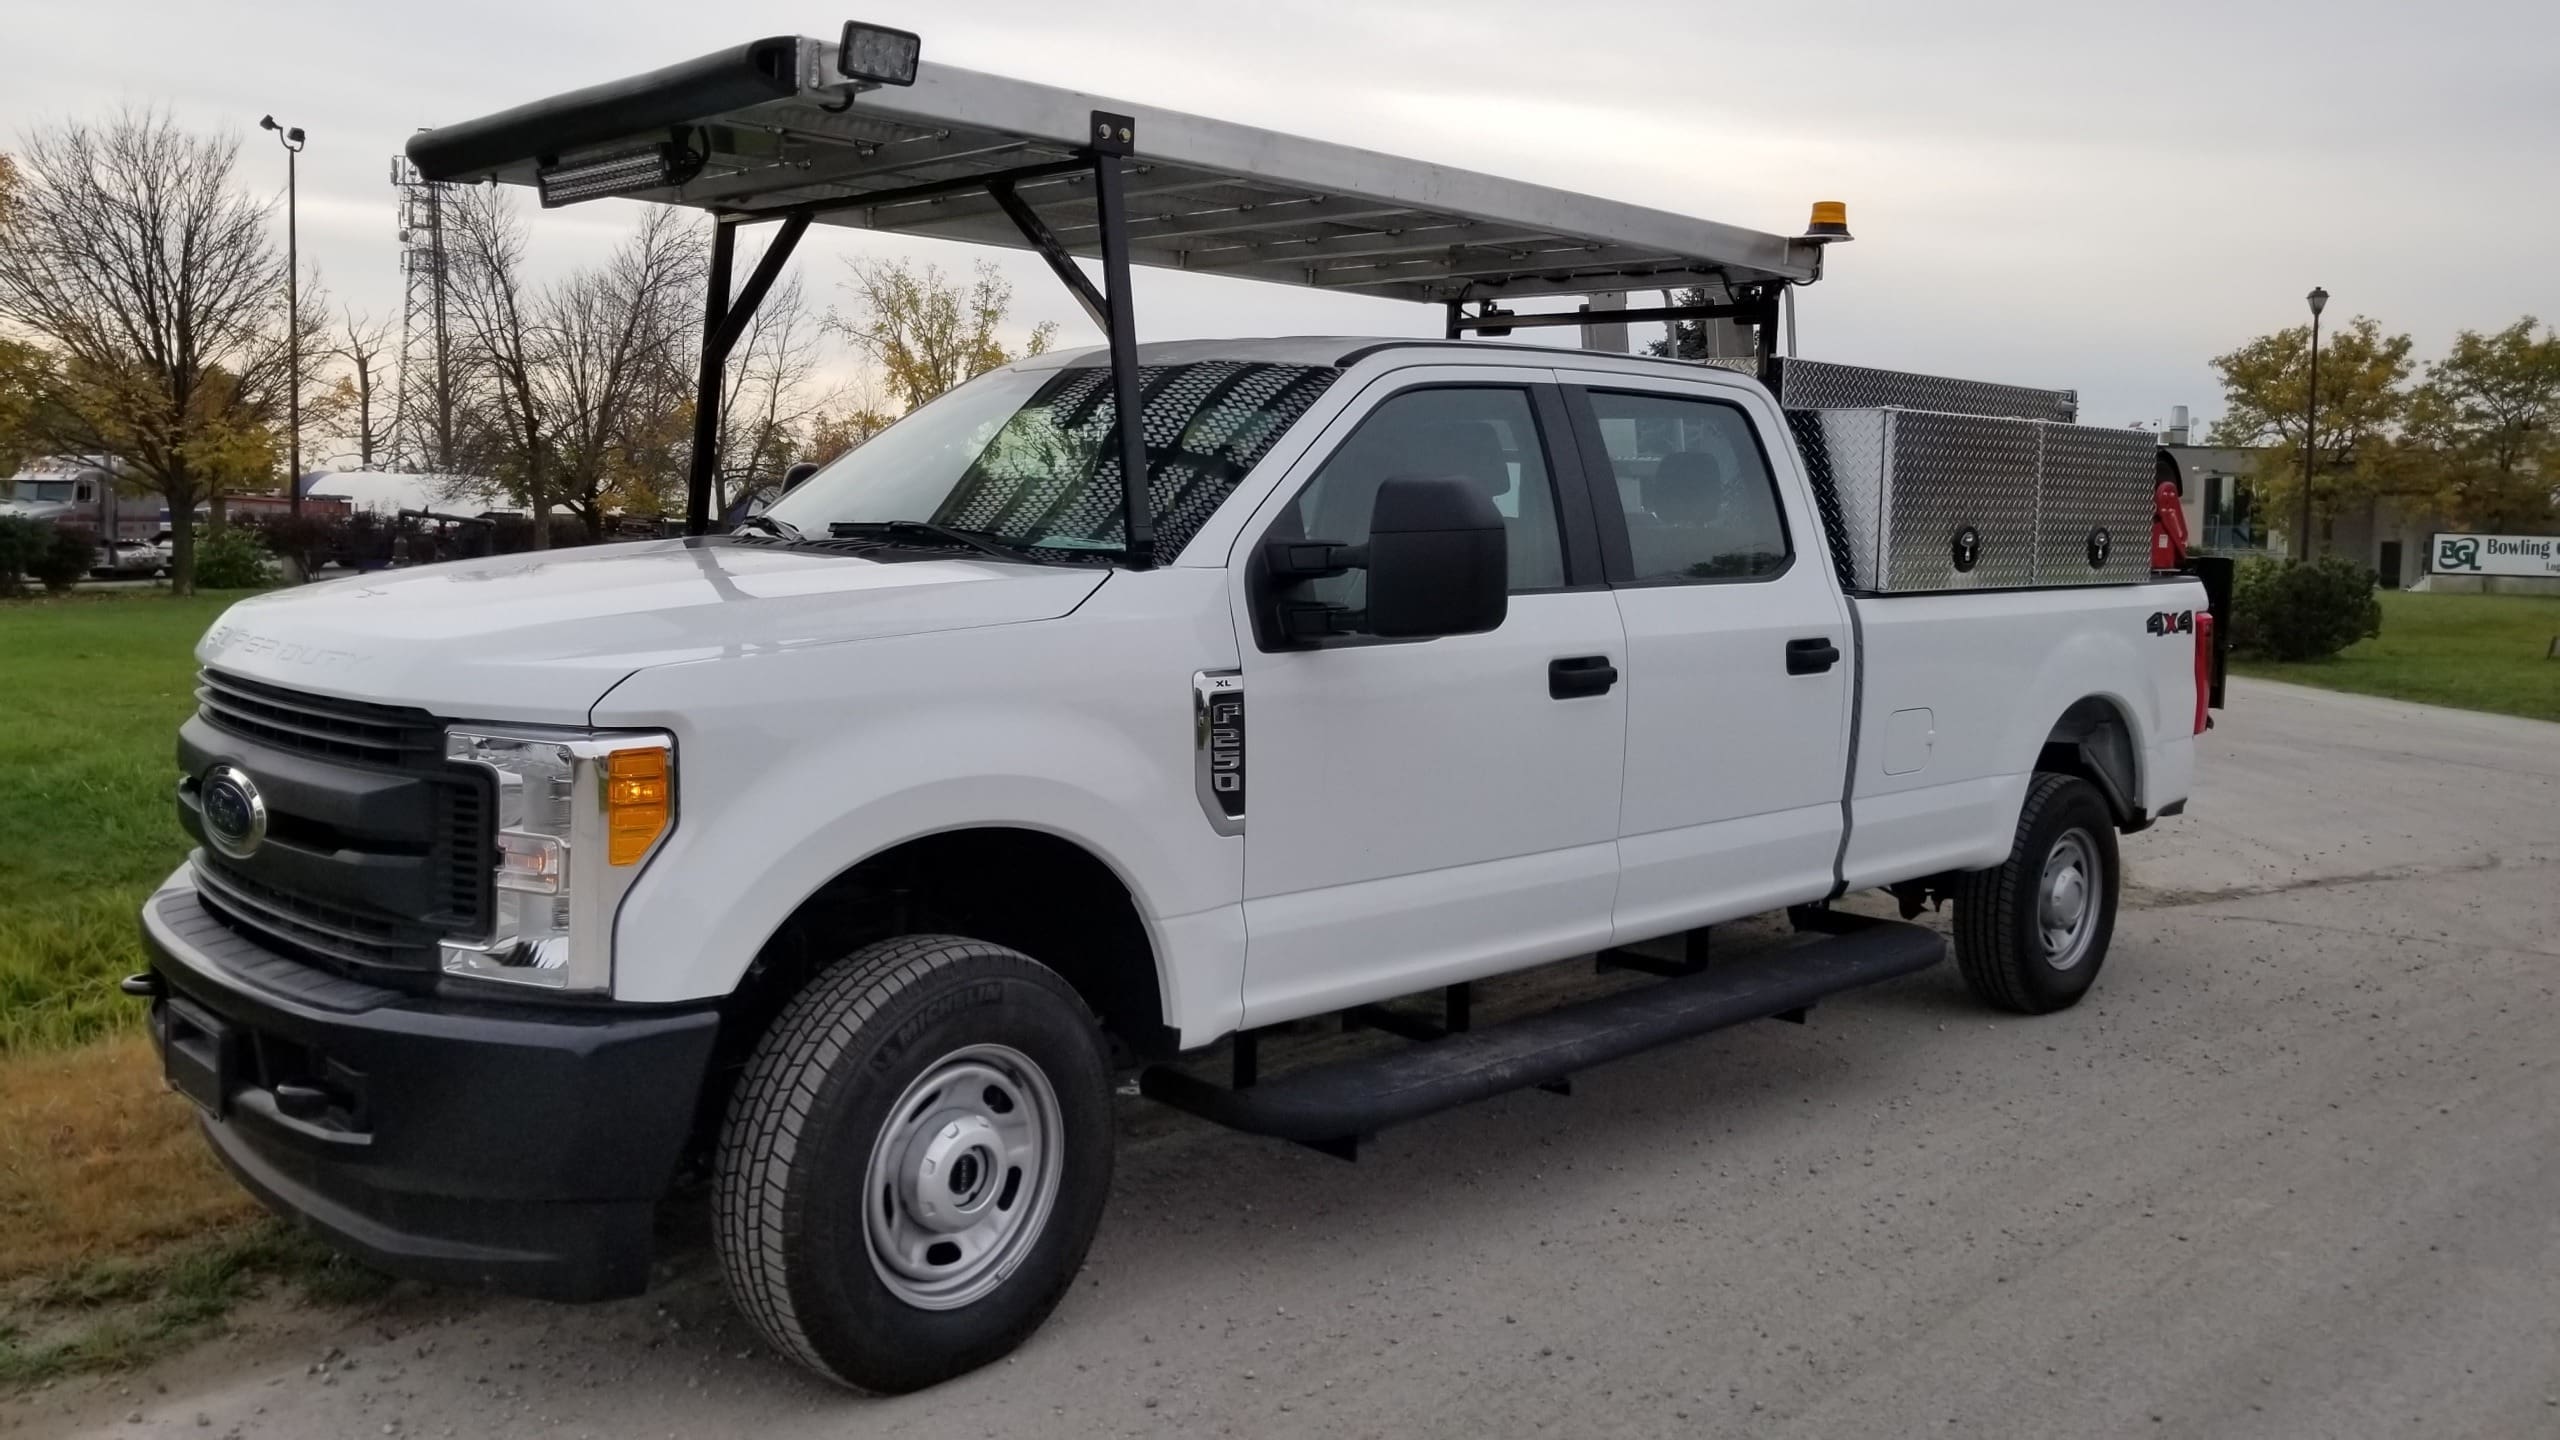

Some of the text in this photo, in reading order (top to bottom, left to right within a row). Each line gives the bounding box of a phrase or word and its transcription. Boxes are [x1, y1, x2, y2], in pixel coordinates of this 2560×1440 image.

[2439, 538, 2482, 571] BGL
[2487, 539, 2551, 560] Bowling
[1215, 679, 1232, 688] XL
[1213, 702, 1241, 792] F250
